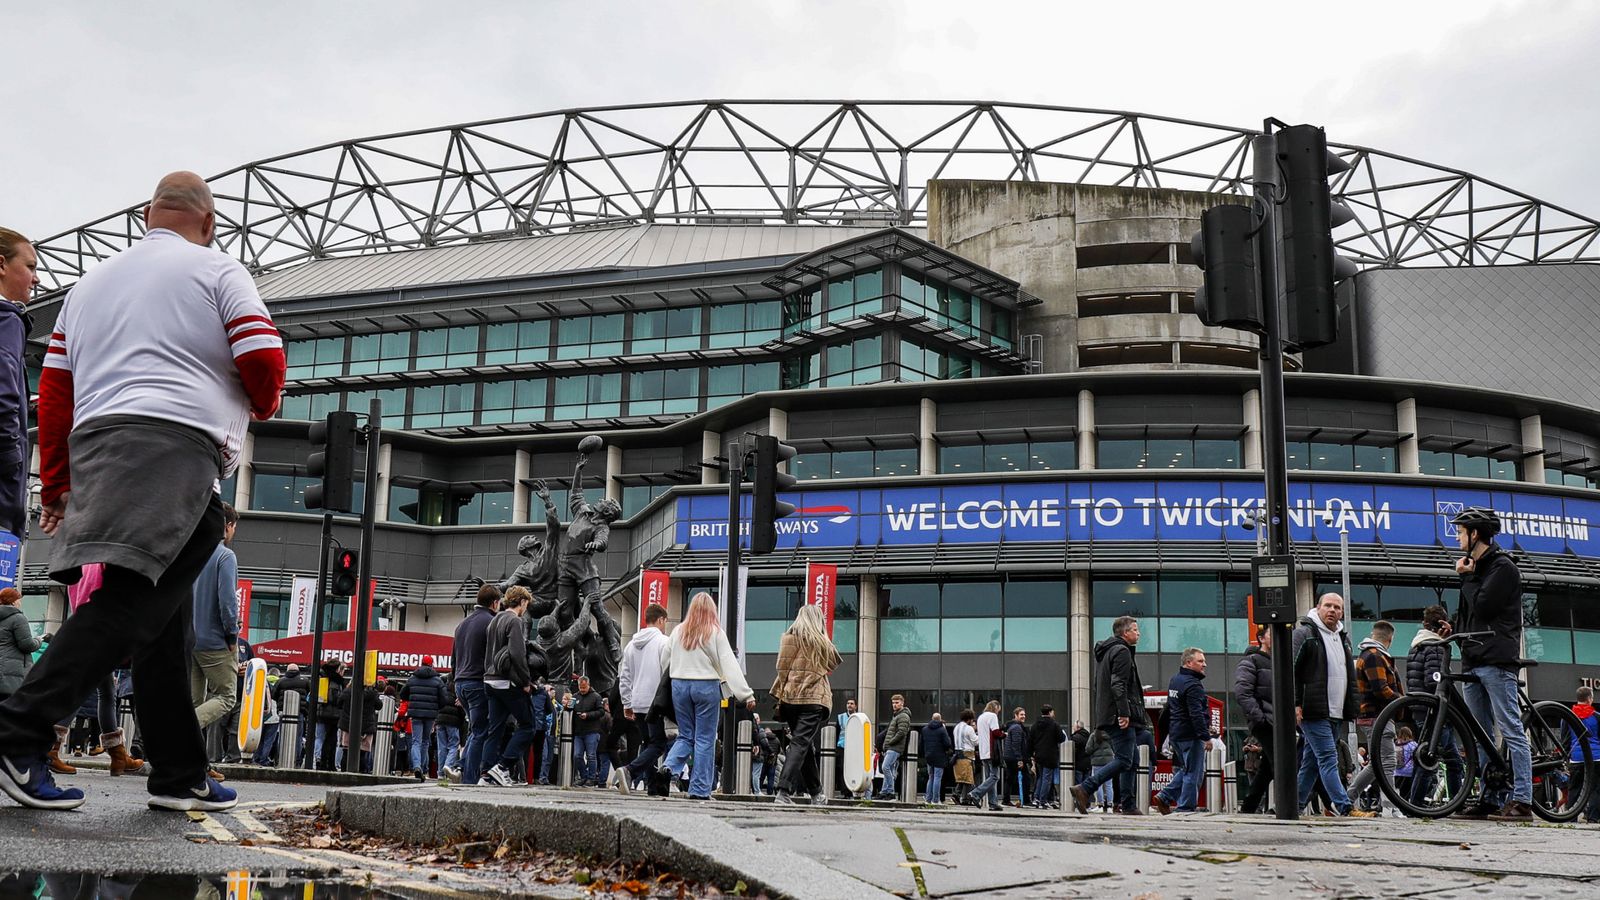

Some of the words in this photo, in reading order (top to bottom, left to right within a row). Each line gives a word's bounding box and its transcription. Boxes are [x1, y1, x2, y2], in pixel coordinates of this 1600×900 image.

[886, 499, 1061, 531] WELCOME
[1071, 497, 1124, 527] TO
[1494, 511, 1589, 541] ICKENHAM
[691, 522, 750, 537] BRITIH
[773, 520, 819, 535] RWAYS
[648, 579, 658, 606] DA
[296, 587, 307, 636] HONDA
[378, 652, 452, 668] MERCAN
